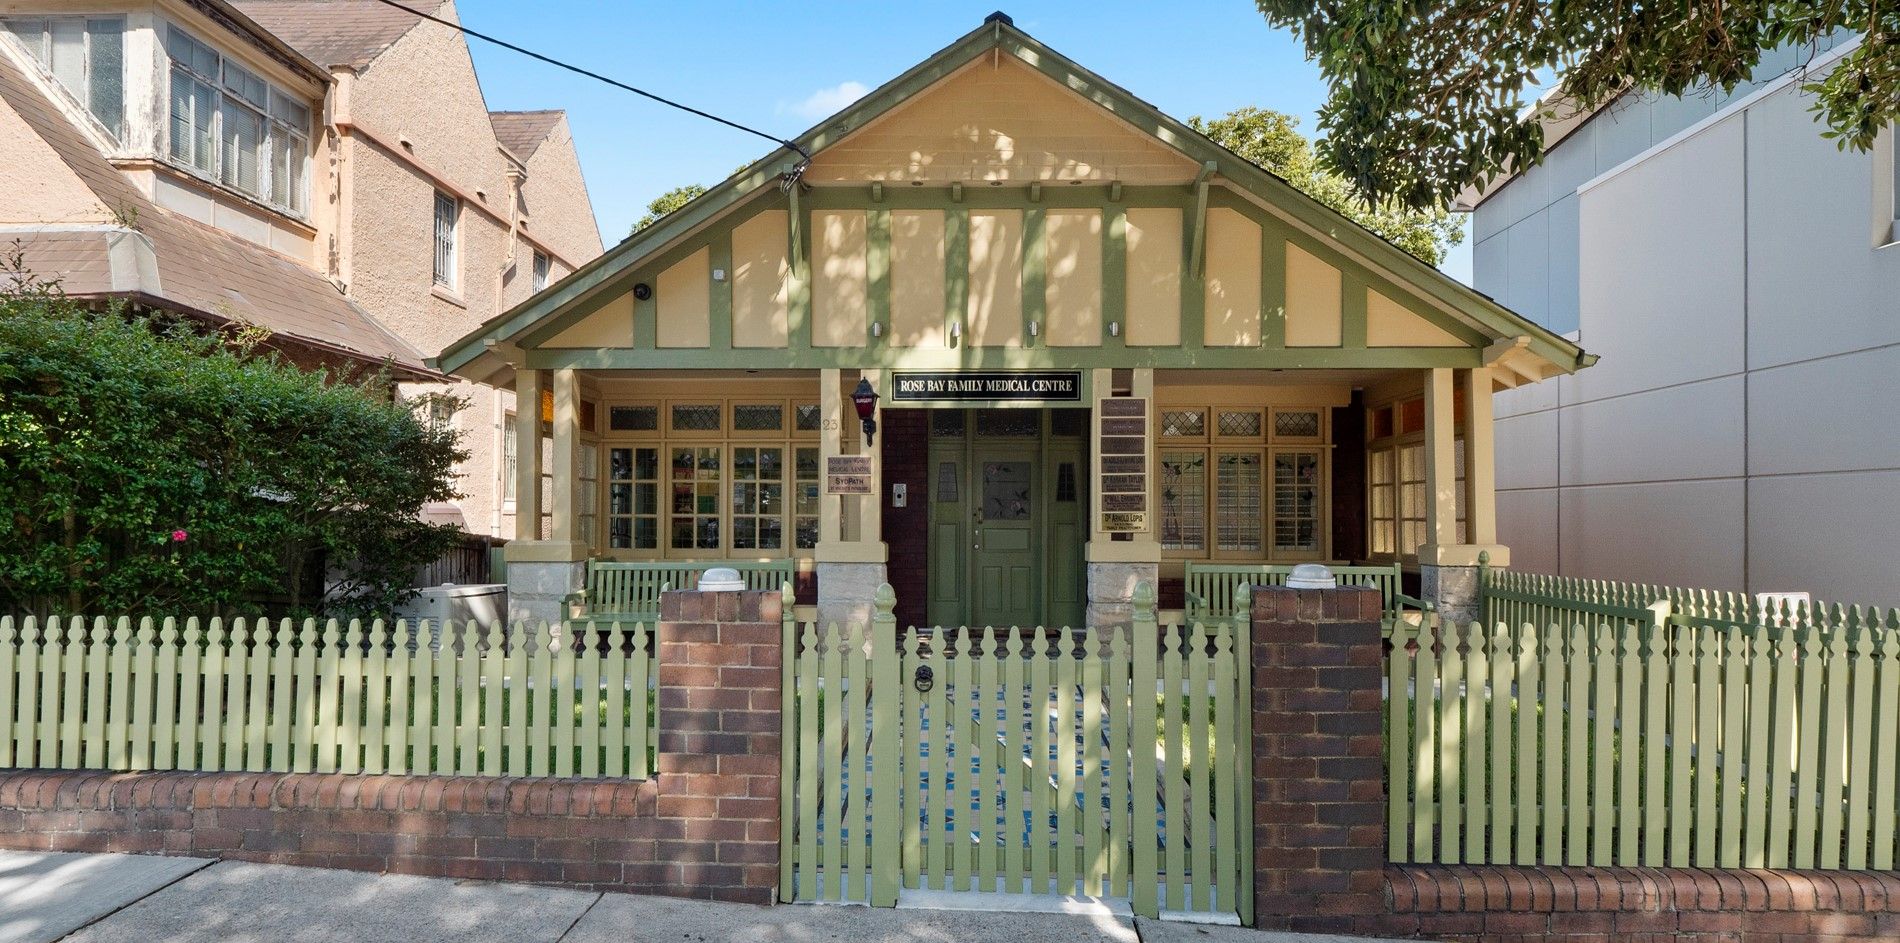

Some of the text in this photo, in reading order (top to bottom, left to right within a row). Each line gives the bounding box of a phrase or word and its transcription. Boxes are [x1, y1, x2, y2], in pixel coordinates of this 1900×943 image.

[900, 380, 1073, 392] ROSE BAY FAMILY MEDICAL CENTRE
[823, 419, 838, 430] 23
